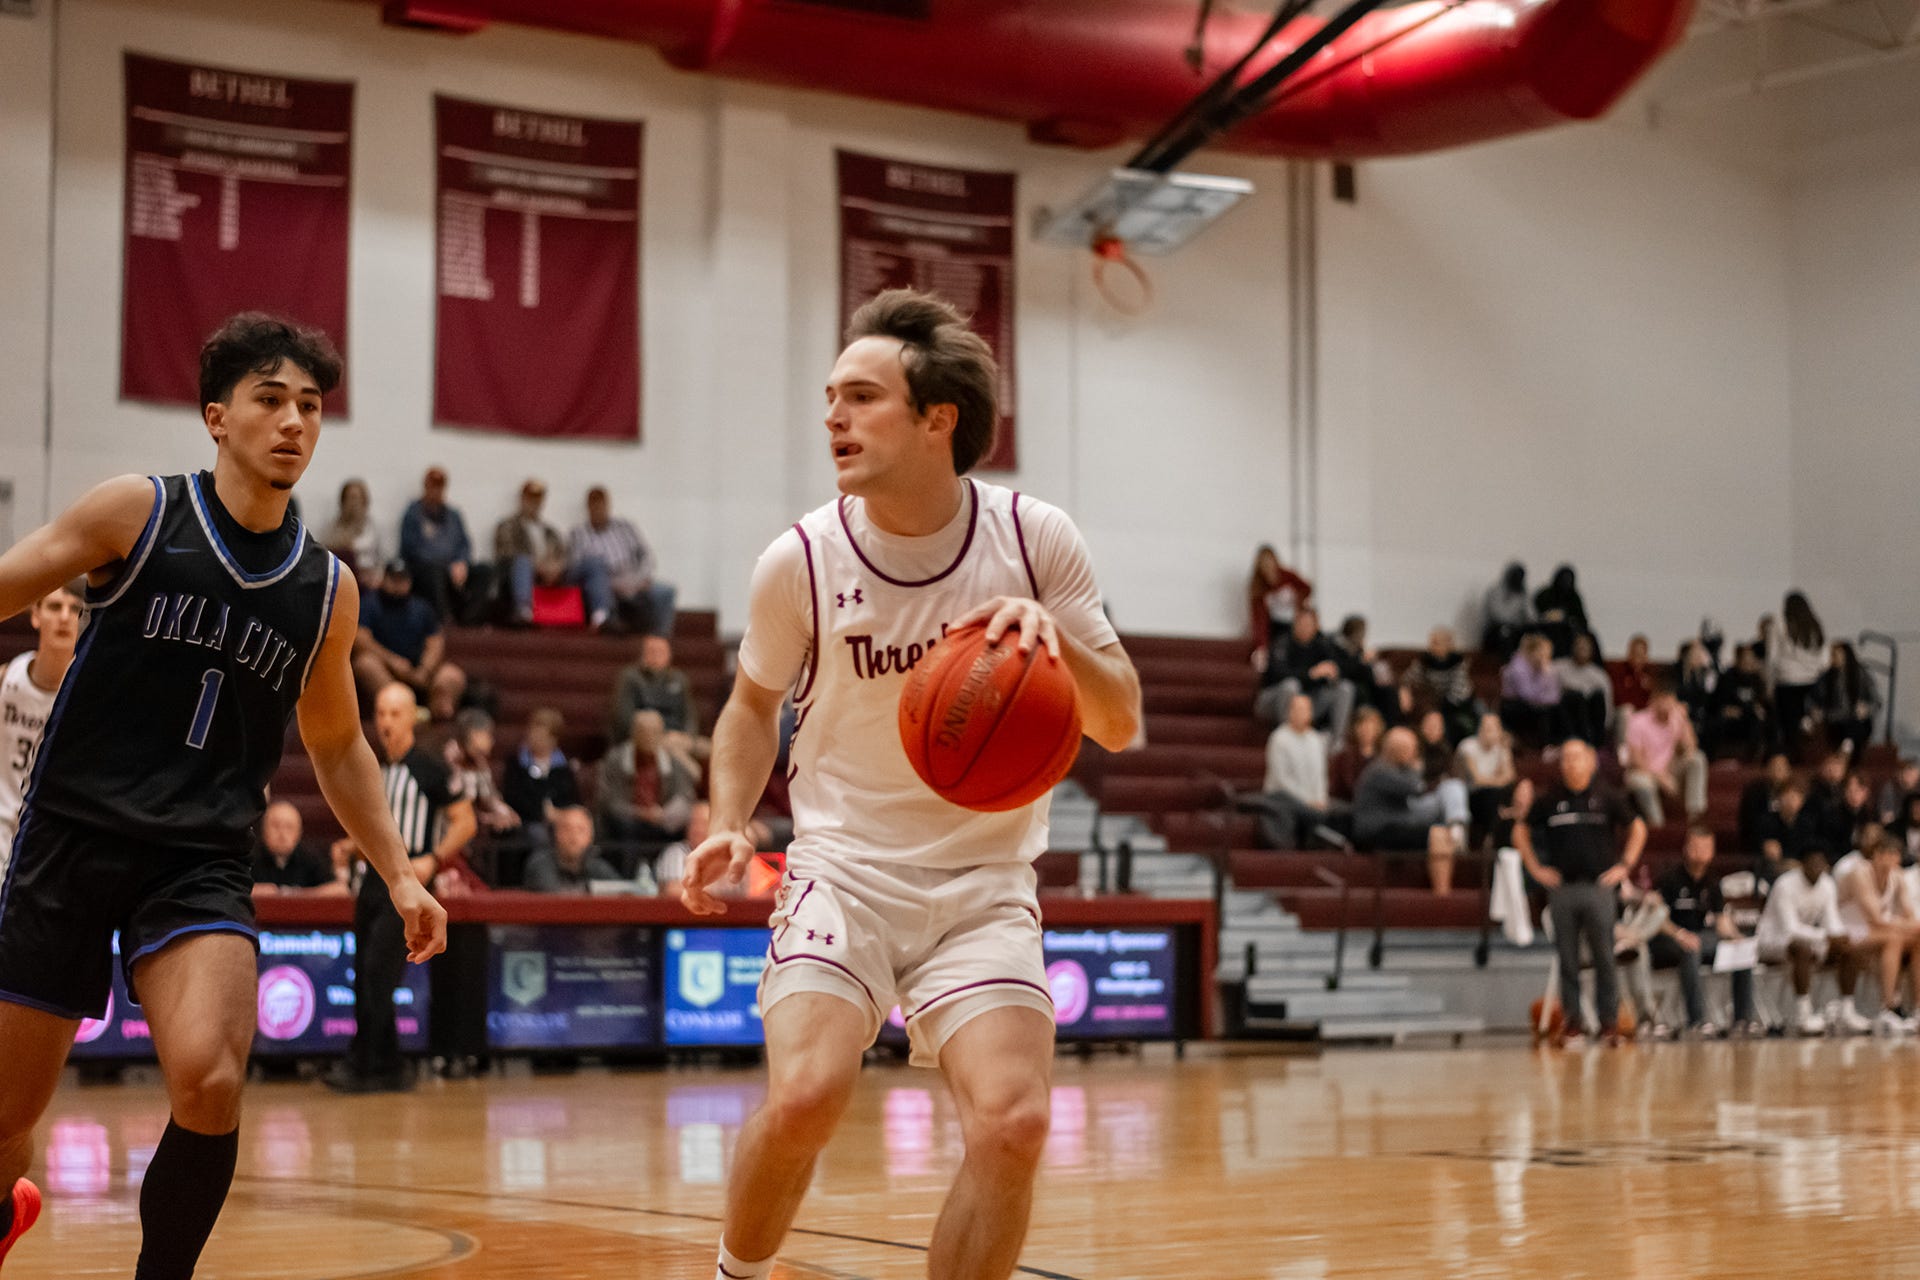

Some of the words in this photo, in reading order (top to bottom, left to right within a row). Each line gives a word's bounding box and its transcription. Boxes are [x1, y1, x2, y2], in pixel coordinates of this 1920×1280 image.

[189, 69, 294, 109] BETHEL
[143, 592, 231, 651] OKLA
[234, 616, 297, 692] CITY
[185, 667, 225, 750] 1
